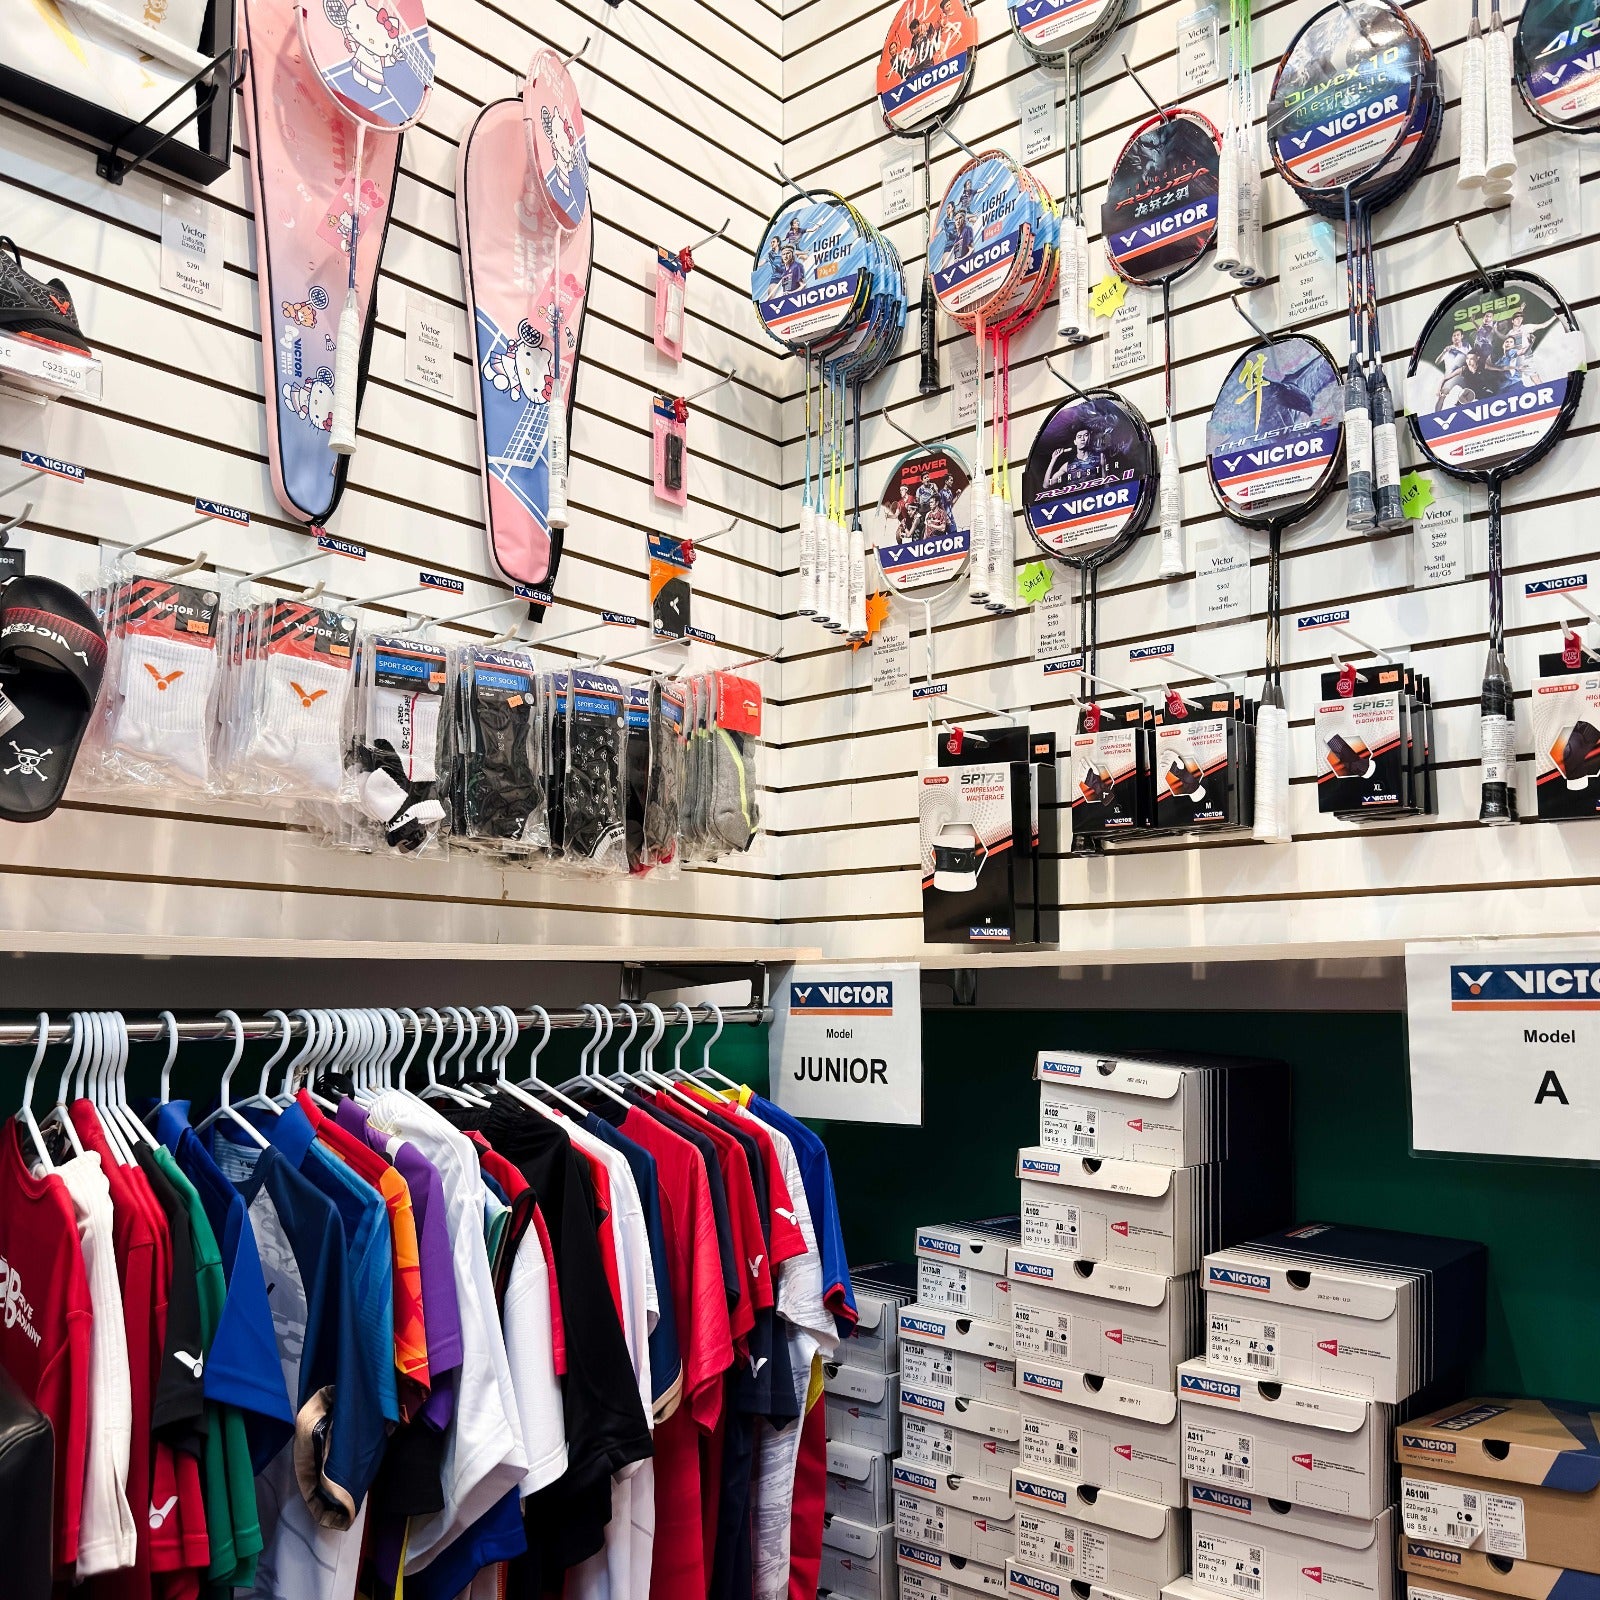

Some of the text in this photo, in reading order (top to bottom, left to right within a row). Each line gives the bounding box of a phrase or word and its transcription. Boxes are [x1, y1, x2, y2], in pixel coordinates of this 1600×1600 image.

[1368, 45, 1400, 70] 10
[906, 59, 959, 93] VICTOR
[1317, 94, 1399, 138] VICTOR
[1530, 168, 1558, 182] Victor
[982, 190, 1007, 213] LIGHT
[982, 198, 1016, 228] WEIGHT
[1141, 203, 1208, 238] VICTOR
[181, 222, 207, 240] Victor
[813, 233, 842, 253] LIGHT
[814, 243, 853, 266] WEIGHT
[958, 239, 1011, 275] VICTOR
[1295, 249, 1318, 262] Victor
[788, 281, 849, 309] VICTOR
[1117, 305, 1138, 316] Victor
[1453, 293, 1521, 321] SPEED
[421, 321, 441, 336] Victor
[921, 321, 929, 355] VICTOR
[294, 336, 304, 379] VICTOR
[42, 360, 81, 379] C$235.00
[1461, 387, 1554, 422] VICTOR
[1246, 437, 1324, 466] VICTOR
[41, 456, 83, 478] VICTOR
[901, 458, 947, 477] POWER
[1048, 461, 1120, 486] THRUSTER
[1061, 488, 1129, 515] VICTOR
[212, 502, 248, 522] VICTOR
[1425, 509, 1452, 521] Victor
[331, 540, 365, 556] VICTOR
[906, 535, 964, 559] VICTOR
[1211, 556, 1233, 567] Victor
[432, 575, 463, 590] VICTOR
[1023, 570, 1045, 593] SALE!
[1546, 576, 1587, 590] VICTOR
[525, 588, 552, 603] VICTOR
[154, 601, 194, 616] VICTOR
[612, 612, 637, 624] VICTOR
[1311, 611, 1349, 624] VICTOR
[295, 622, 332, 638] VICTOR
[694, 628, 715, 641] VICTOR
[394, 639, 441, 654] VICTOR
[1147, 644, 1174, 656] VICTOR
[379, 660, 423, 673] SPORT SOCKS
[490, 655, 529, 669] VICTOR
[1056, 659, 1082, 670] VICTOR
[478, 675, 518, 686] SPORT SOCKS
[588, 680, 618, 693] VICTOR
[923, 684, 947, 697] VICTOR
[577, 700, 610, 711] SPORT SOCKS
[1352, 699, 1394, 711] SP163
[960, 771, 1005, 785] SP173
[961, 785, 1005, 794] COMPRESSION
[981, 928, 1009, 937] VICTOR
[818, 985, 889, 1004] VICTOR
[825, 1028, 853, 1040] Model
[1523, 1029, 1576, 1043] Model
[793, 1056, 889, 1085] JUNIOR
[1055, 1063, 1080, 1074] VICTOR
[1534, 1070, 1570, 1105] A
[1044, 1108, 1059, 1117] A102
[1034, 1161, 1059, 1172] VICTOR
[1025, 1207, 1040, 1216] A102
[1055, 1223, 1064, 1231] AB
[930, 1239, 959, 1253] VICTOR
[1027, 1263, 1052, 1276] VICTOR
[1226, 1271, 1268, 1288] VICTOR
[1015, 1311, 1030, 1321] A102
[913, 1320, 944, 1334] VICTOR
[1211, 1321, 1228, 1332] A311
[1249, 1340, 1258, 1350] AF
[1035, 1374, 1061, 1388] VICTOR
[1197, 1379, 1239, 1396] VICTOR
[914, 1395, 944, 1410] VICTOR
[1024, 1423, 1039, 1433] A102
[1187, 1431, 1203, 1442] A311
[1417, 1438, 1455, 1453] VICTOR
[1224, 1452, 1233, 1461] AF
[905, 1472, 935, 1488] VICTOR
[1030, 1484, 1065, 1502] VICTOR
[1209, 1490, 1249, 1509] VICTOR
[1405, 1487, 1429, 1501] A610II
[1406, 1502, 1417, 1510] 220
[1406, 1512, 1419, 1520] EUR
[1456, 1511, 1463, 1520] C
[1406, 1522, 1415, 1530] US
[1198, 1540, 1214, 1551] A311
[912, 1549, 940, 1565] VICTOR
[1422, 1546, 1460, 1564] VICTOR
[1235, 1561, 1244, 1571] AF
[1024, 1578, 1058, 1595] VICTOR
